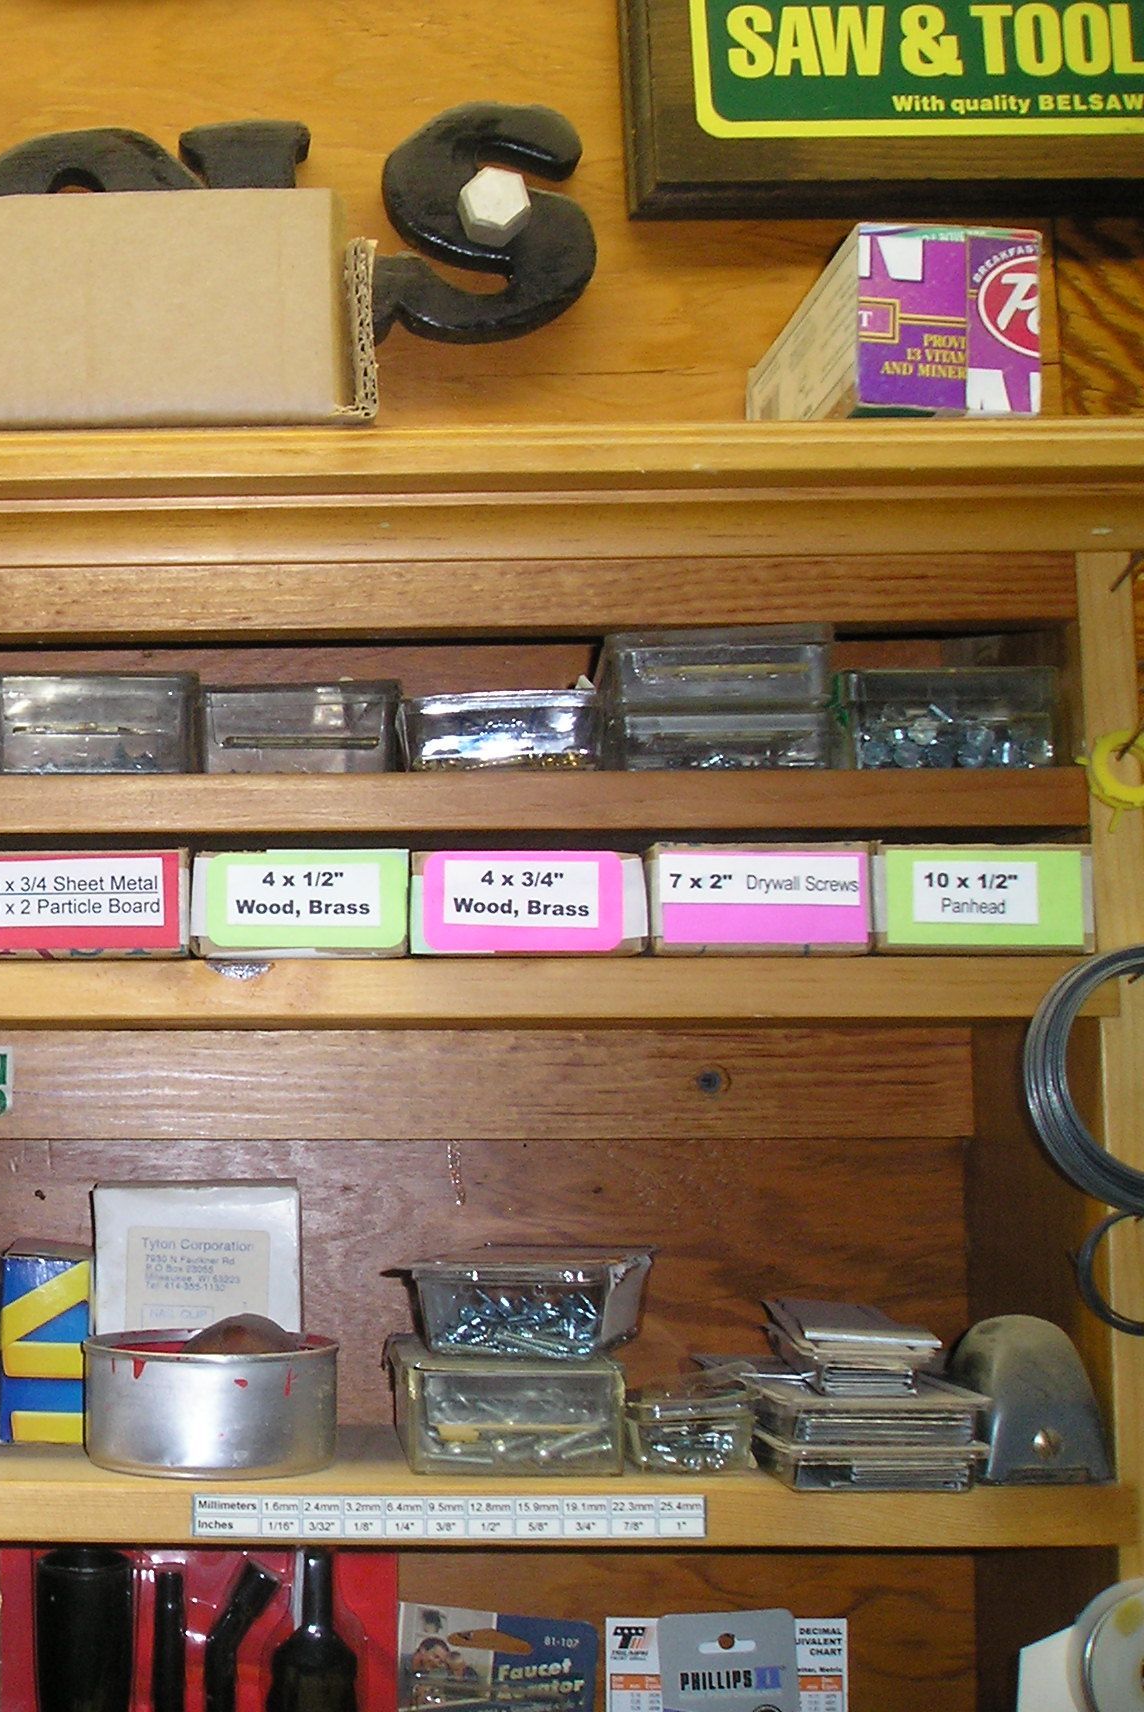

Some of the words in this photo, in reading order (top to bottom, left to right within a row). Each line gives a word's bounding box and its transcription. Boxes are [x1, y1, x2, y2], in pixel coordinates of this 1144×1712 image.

[726, 4, 885, 79] SAW
[899, 4, 963, 78] &
[891, 94, 946, 112] With
[951, 94, 1031, 114] quality
[1038, 93, 1144, 111] BELSAW
[880, 361, 913, 376] AND
[5, 880, 15, 891] x
[20, 876, 47, 892] 3/4
[53, 876, 105, 892] Sheet
[110, 875, 158, 890] Metal
[262, 871, 276, 887] 4
[282, 875, 295, 887] x
[303, 871, 344, 887] 1/2"
[480, 870, 494, 886] 4
[501, 874, 514, 886] x
[521, 871, 564, 887] 3/4"
[669, 873, 682, 888] 7
[689, 877, 702, 889] x
[709, 874, 733, 889] 2"
[746, 874, 800, 894] Drywall
[805, 876, 860, 892] Screws
[924, 873, 949, 888] 10
[956, 876, 969, 888] x
[978, 874, 1018, 889] 1/2"
[5, 904, 15, 914] x
[20, 899, 31, 914] 2
[37, 899, 102, 914] Particle
[108, 898, 160, 914] Board
[236, 899, 301, 917] Wood,
[309, 900, 370, 915] Brass
[453, 897, 519, 917] Wood,
[527, 900, 590, 917] Brass
[941, 898, 1006, 914] Panhead
[181, 1238, 254, 1253] Corporation
[198, 1500, 257, 1510] Millimeters
[263, 1501, 298, 1512] 1.6mm
[304, 1501, 340, 1512] 2.4mm
[345, 1501, 381, 1512] 3.2mm
[428, 1501, 463, 1512] 9.5mm
[566, 1501, 606, 1512] 19.1mm
[612, 1501, 654, 1512] 22.3mm
[660, 1501, 703, 1512] 25.4mm
[198, 1519, 234, 1529] Inches
[799, 1627, 843, 1635] DECIMAL
[809, 1648, 843, 1656] CHART
[497, 1658, 572, 1681] Faucet
[679, 1670, 753, 1692] PHILLIPS
